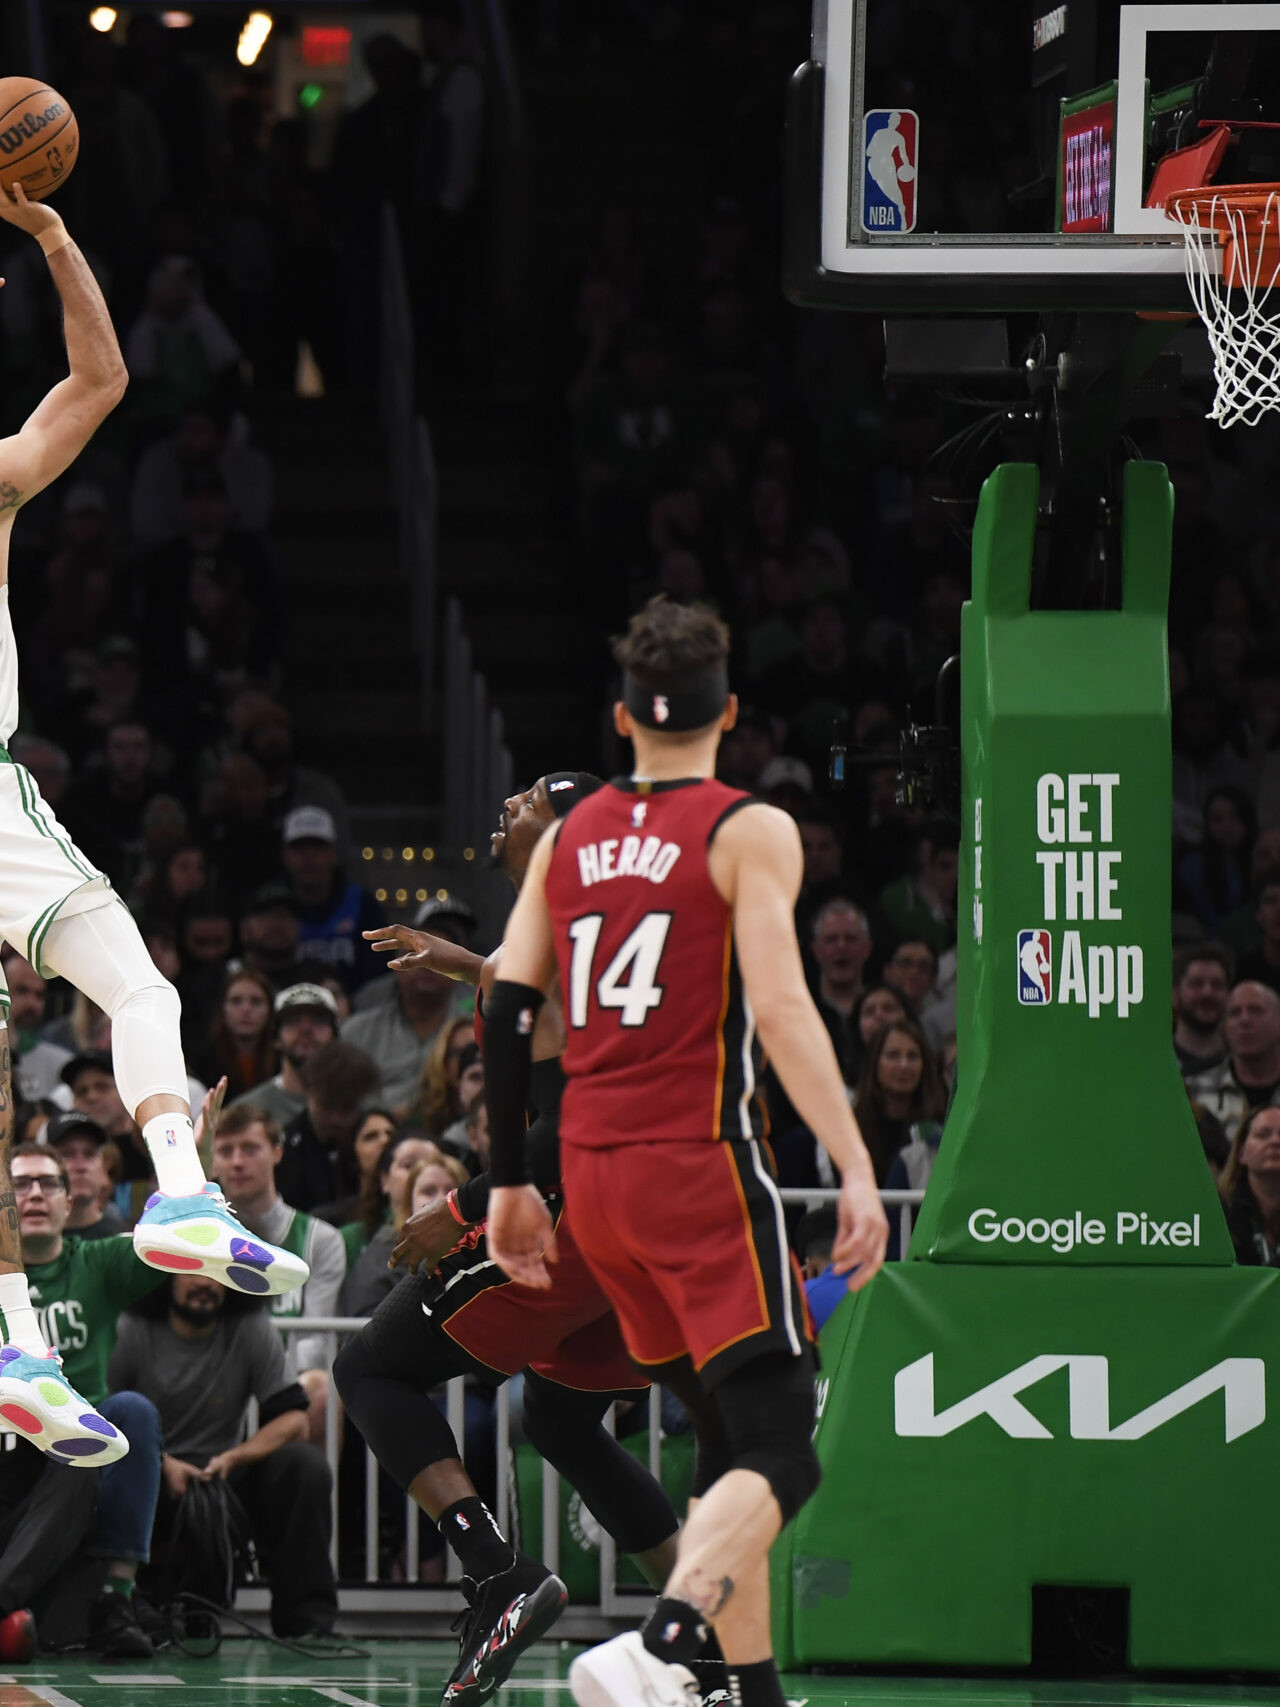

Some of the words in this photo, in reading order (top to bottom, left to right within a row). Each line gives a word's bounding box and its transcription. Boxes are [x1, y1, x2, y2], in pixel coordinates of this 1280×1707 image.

[868, 206, 896, 226] NBA
[1036, 773, 1121, 844] GET
[577, 836, 681, 887] HERRO
[1035, 851, 1123, 921] THE
[568, 911, 674, 1029] 14
[1022, 986, 1040, 1001] NBA
[1057, 930, 1145, 1019] App
[967, 1208, 1106, 1253] Google
[1116, 1211, 1201, 1248] Pixel
